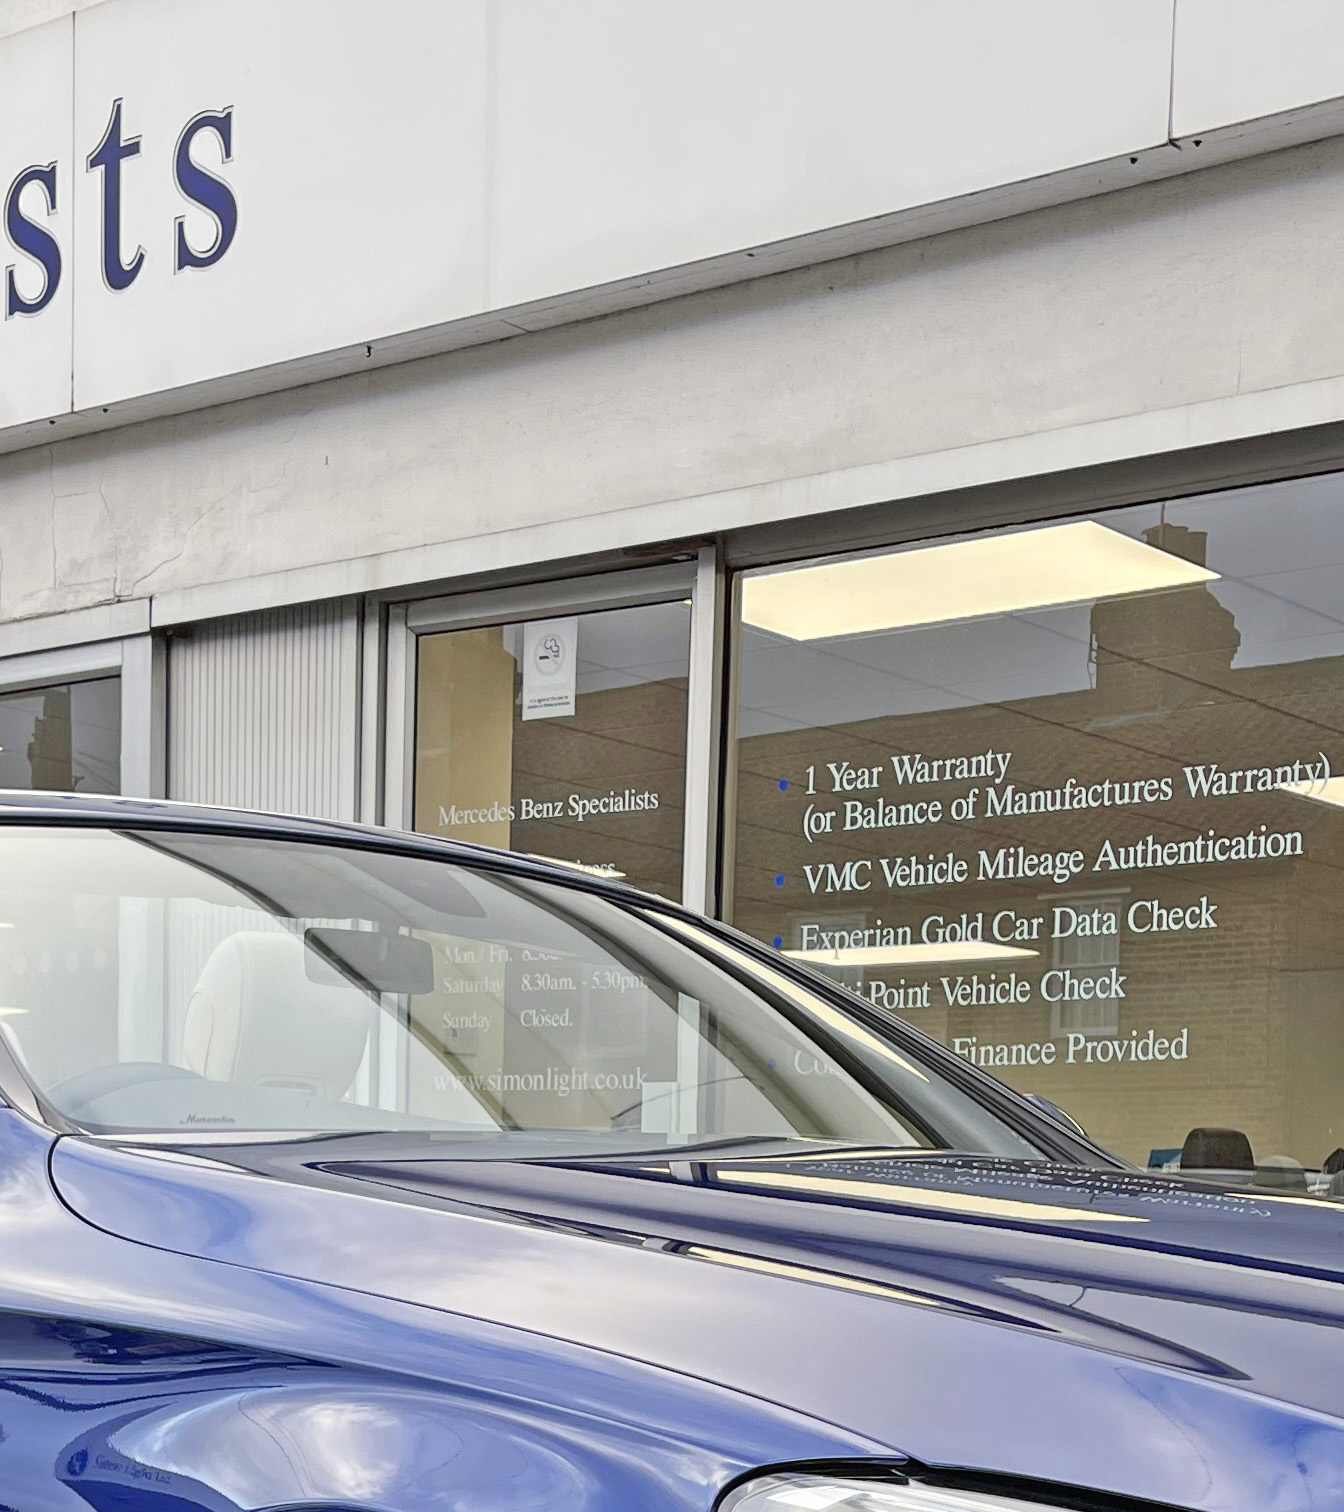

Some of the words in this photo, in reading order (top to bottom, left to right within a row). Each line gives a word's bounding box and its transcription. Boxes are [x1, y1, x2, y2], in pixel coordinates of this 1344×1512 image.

[805, 766, 816, 794] 1
[826, 762, 883, 792] Year
[891, 749, 1012, 784] Warranty
[439, 802, 515, 826] Mercedes
[520, 798, 563, 821] Benz
[568, 789, 659, 821] Specialists
[803, 804, 836, 843] (or
[843, 798, 942, 831] Balance
[951, 787, 979, 820] of
[984, 777, 1173, 818] Manufactures
[1182, 751, 1331, 798] Warranty)
[803, 860, 872, 894] VMC
[879, 853, 968, 888] Vehicle
[977, 846, 1084, 884] Mileage
[1093, 825, 1304, 872] Authentication
[801, 919, 912, 959] Experian
[921, 912, 984, 944] Gold
[993, 910, 1044, 942] Car
[1051, 907, 1118, 938] Data
[1127, 896, 1218, 933] Check
[443, 976, 502, 997] Saturday
[940, 973, 1031, 1006] Vehicle
[1040, 967, 1127, 1002] Check
[443, 1012, 492, 1032] Sunday
[520, 1008, 573, 1027] Closed.
[952, 1037, 1056, 1067] Finance
[1065, 1027, 1188, 1064] Provided
[433, 1067, 648, 1097] www.simonlight.co.uk
